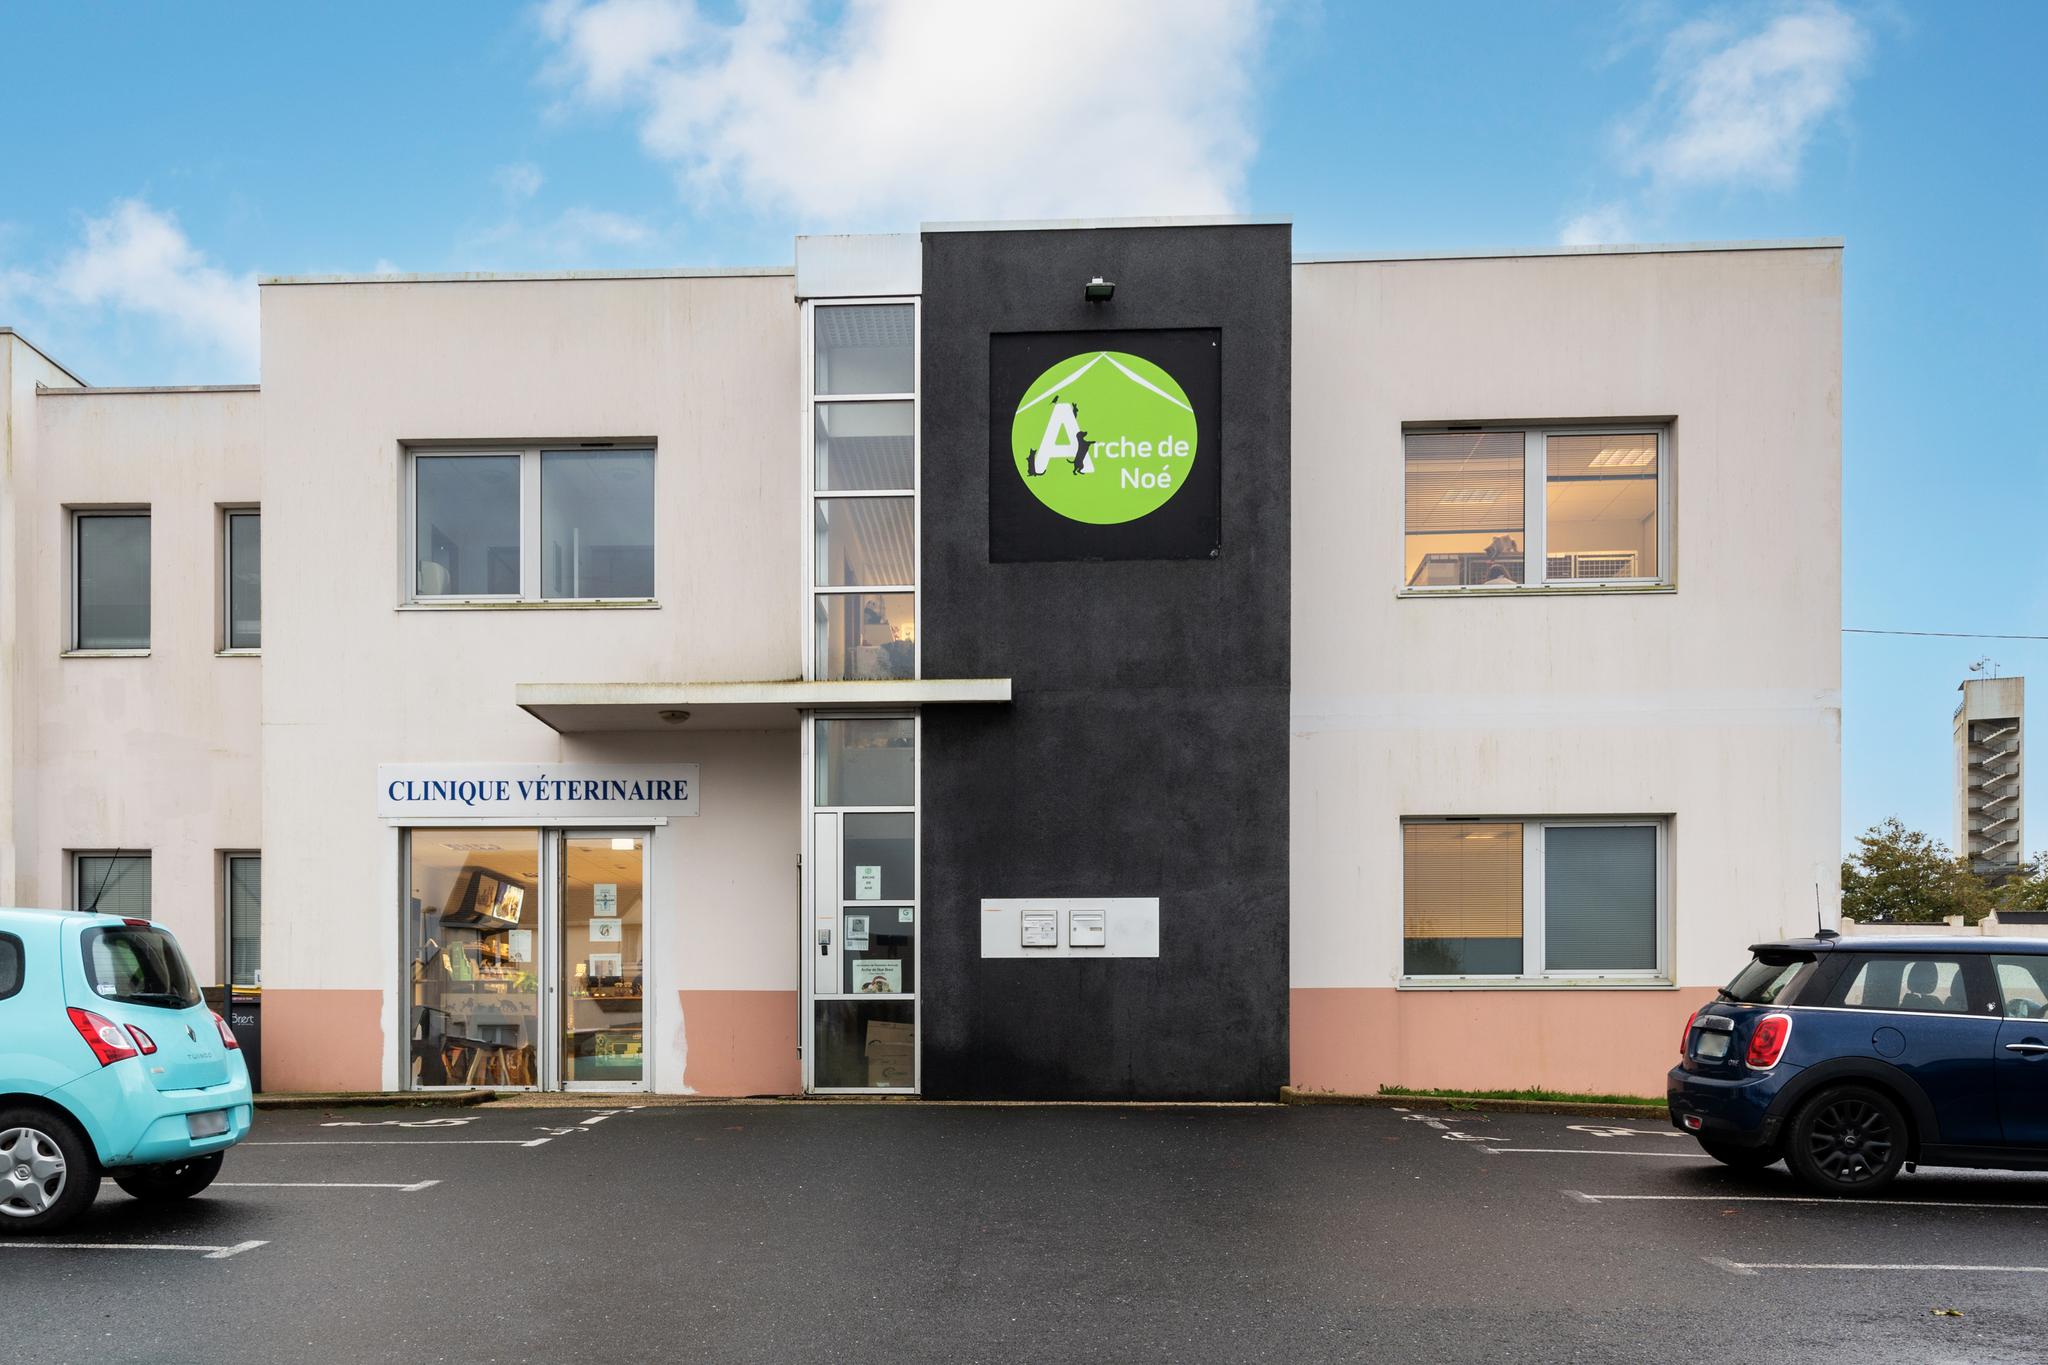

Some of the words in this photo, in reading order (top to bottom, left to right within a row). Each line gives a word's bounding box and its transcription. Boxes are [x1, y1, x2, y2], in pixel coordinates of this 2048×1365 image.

[1034, 403, 1152, 475] Arche
[1158, 435, 1189, 457] de
[1121, 465, 1172, 489] Noé
[388, 780, 510, 807] CLINIQUE
[517, 774, 689, 801] VÉTERINAIRE
